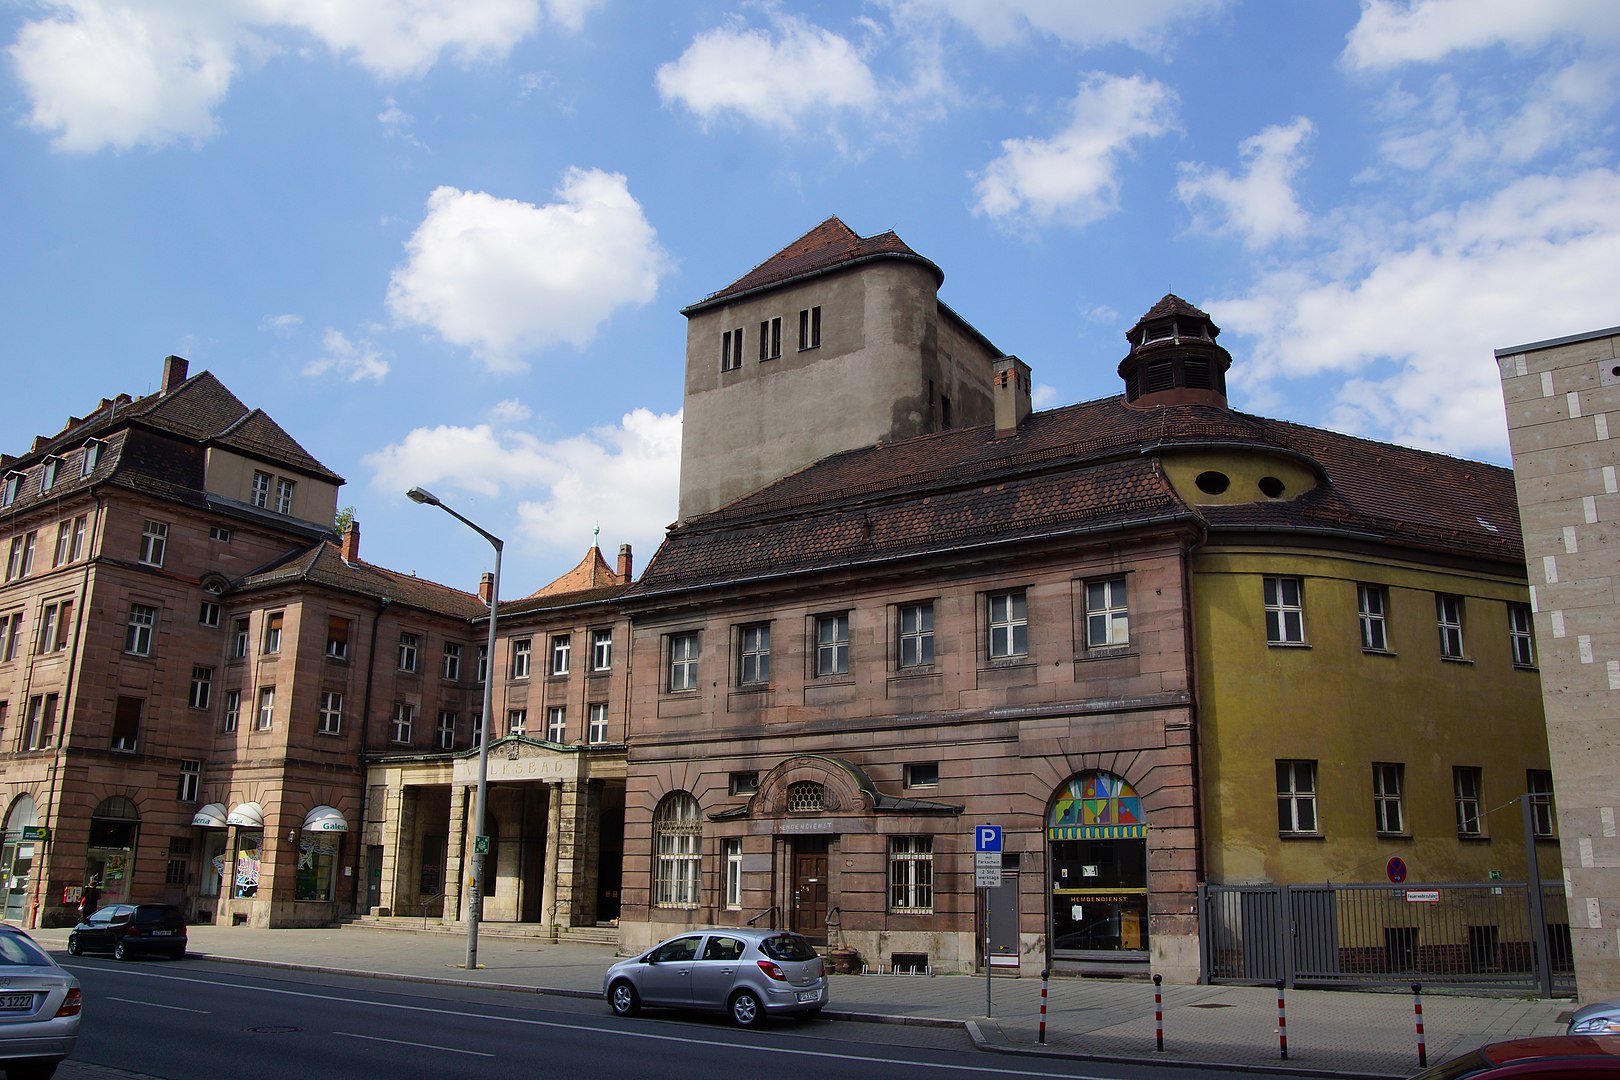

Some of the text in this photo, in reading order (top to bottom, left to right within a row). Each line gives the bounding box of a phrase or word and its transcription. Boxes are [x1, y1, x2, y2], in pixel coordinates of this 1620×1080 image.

[466, 762, 563, 776] VLKSBAD
[981, 829, 996, 849] P
[7, 996, 32, 1007] 1227
